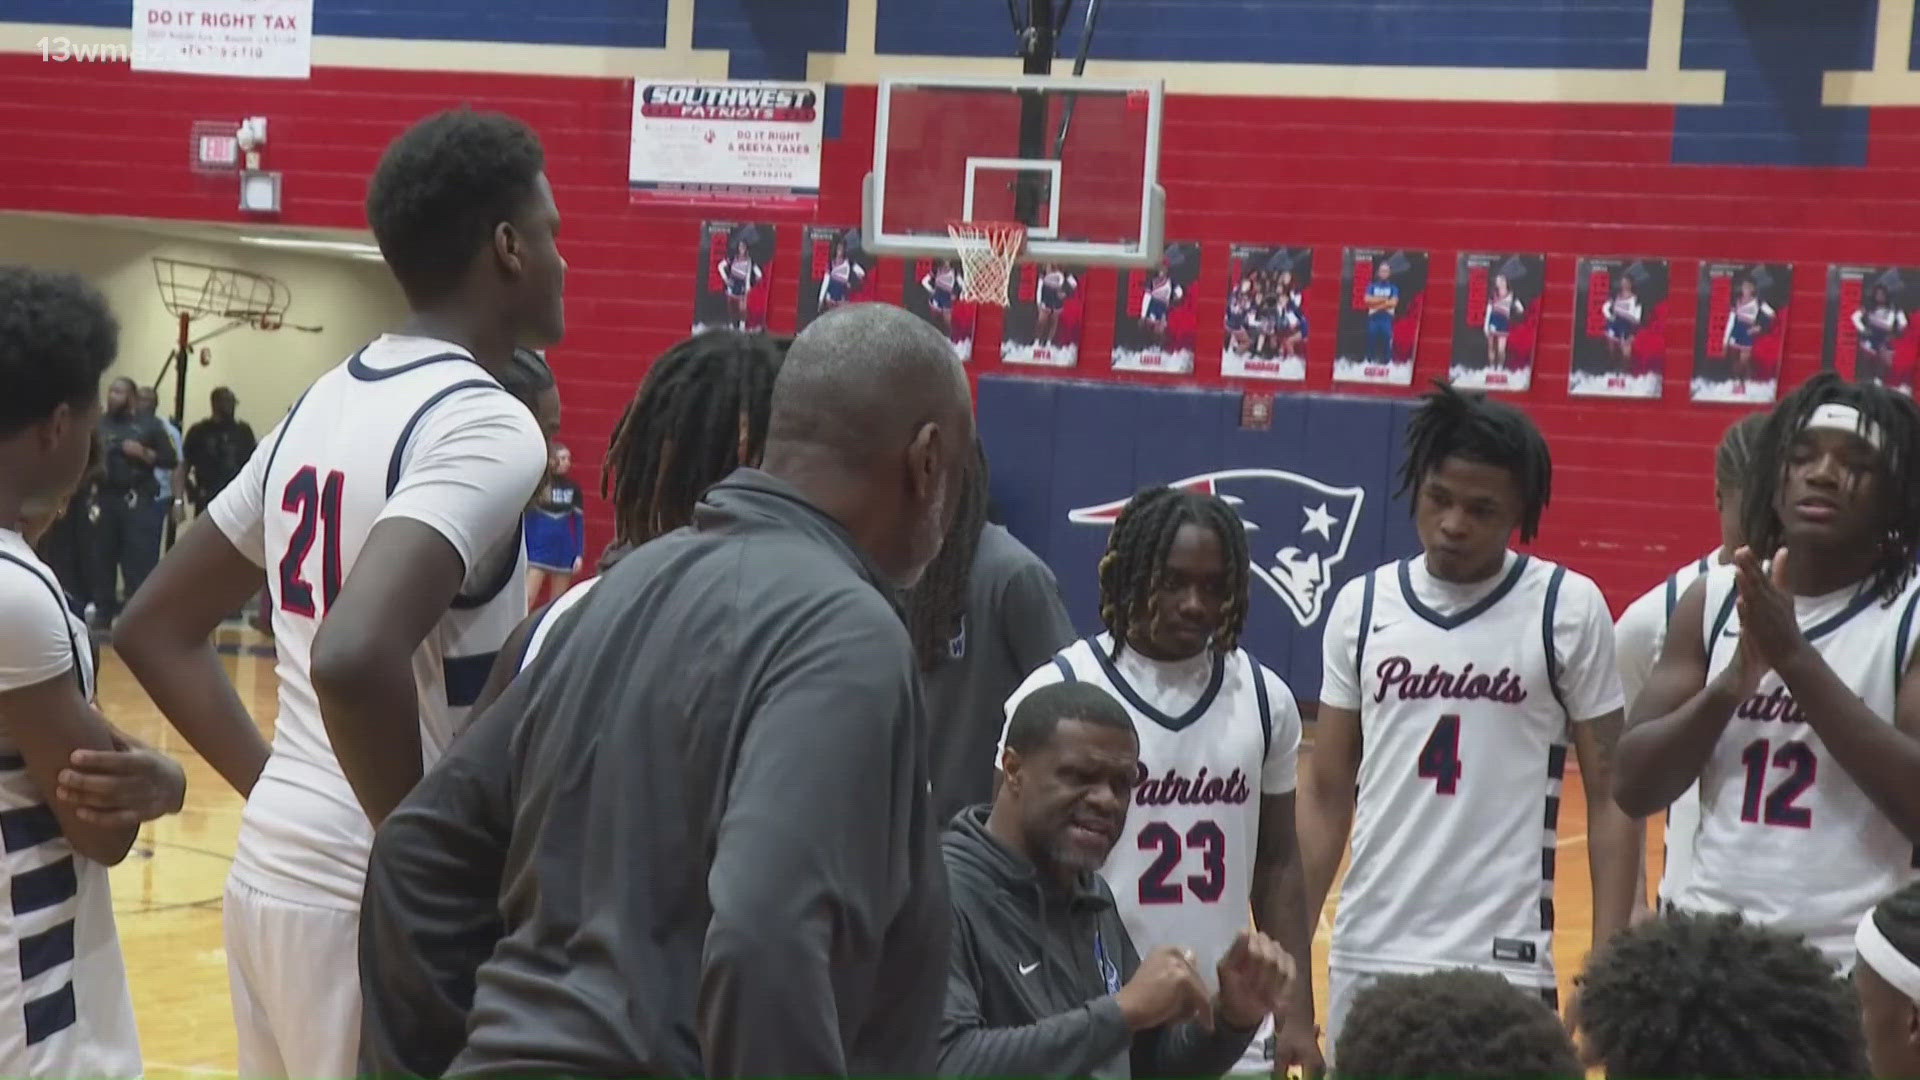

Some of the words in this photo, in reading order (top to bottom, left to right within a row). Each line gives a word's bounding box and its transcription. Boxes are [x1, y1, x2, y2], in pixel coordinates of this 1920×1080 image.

[148, 10, 172, 25] DO
[178, 12, 195, 26] IT
[201, 13, 256, 29] RIGHT
[263, 15, 297, 30] TAX
[650, 86, 811, 108] SOUTHWEST
[681, 106, 774, 119] PATRIOTS
[737, 130, 750, 140] DO
[754, 131, 764, 141] IT
[768, 132, 800, 142] RIGHT
[738, 143, 773, 153] KEEYA
[778, 145, 810, 155] TAXES
[280, 465, 345, 619] 21
[1374, 656, 1528, 705] Patriots
[1418, 713, 1462, 796] 4
[1741, 738, 1818, 830] 12
[1137, 819, 1226, 905] 23
